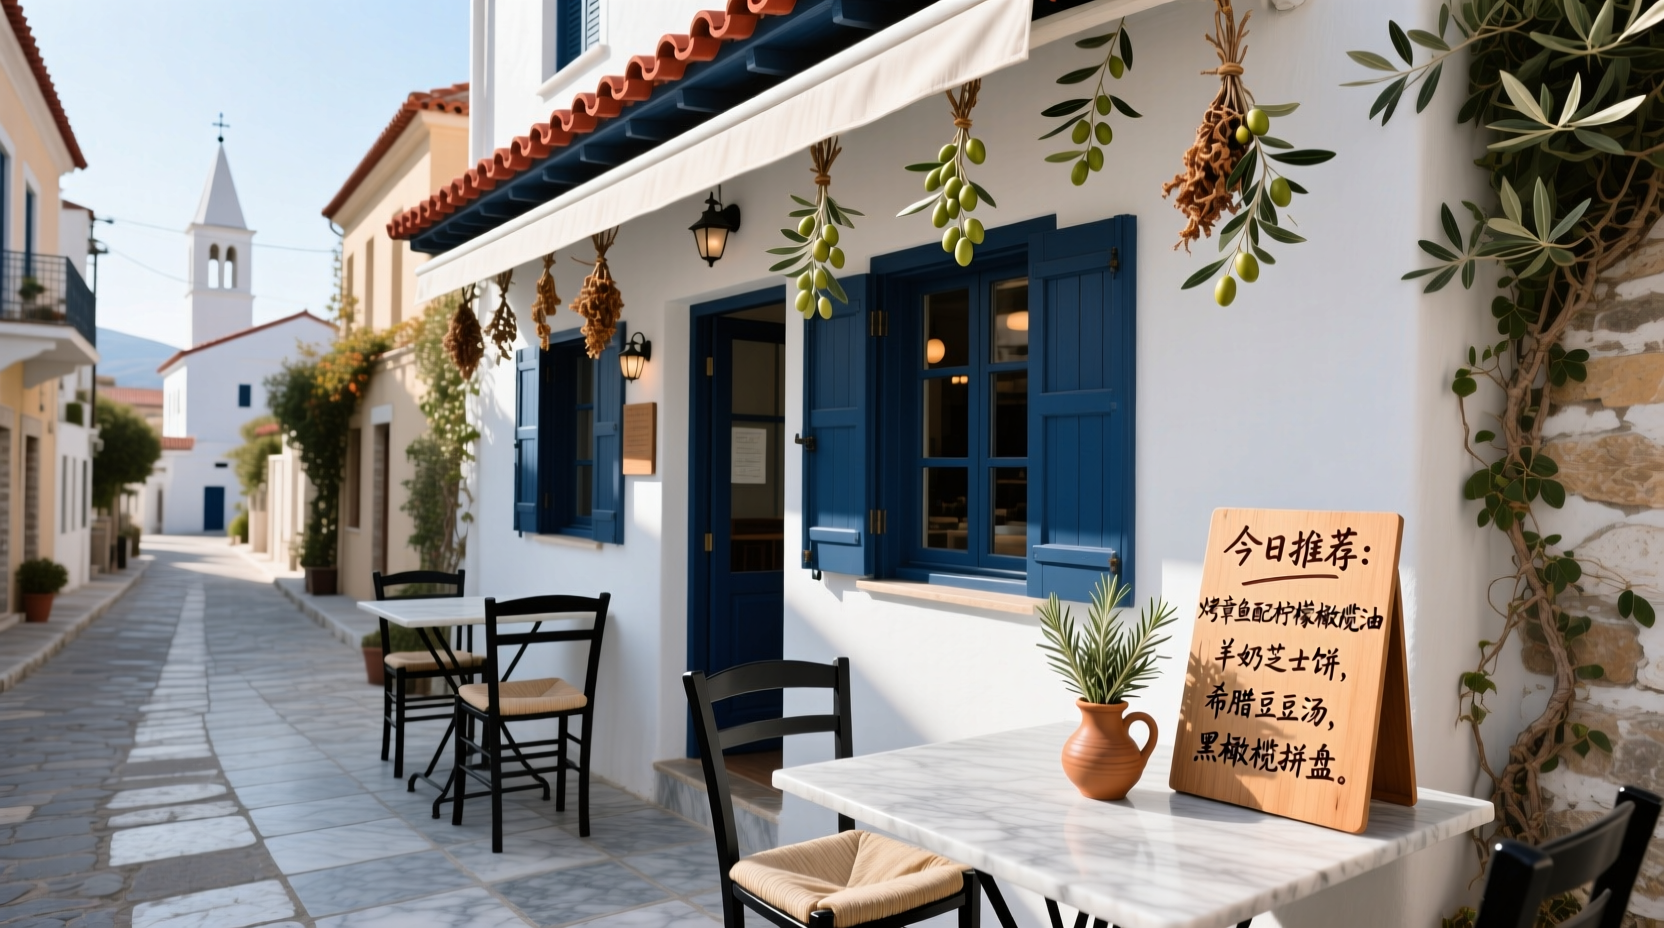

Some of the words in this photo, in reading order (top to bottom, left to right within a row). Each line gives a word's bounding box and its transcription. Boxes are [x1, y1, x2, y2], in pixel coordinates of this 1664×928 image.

[1223, 525, 1371, 571] 今日推荐：
[1214, 638, 1347, 682] 羊奶芝士饼，
[1204, 681, 1335, 731] 希腊豆豆汤，
[1193, 731, 1346, 785] 黑橄榄拼盘。
